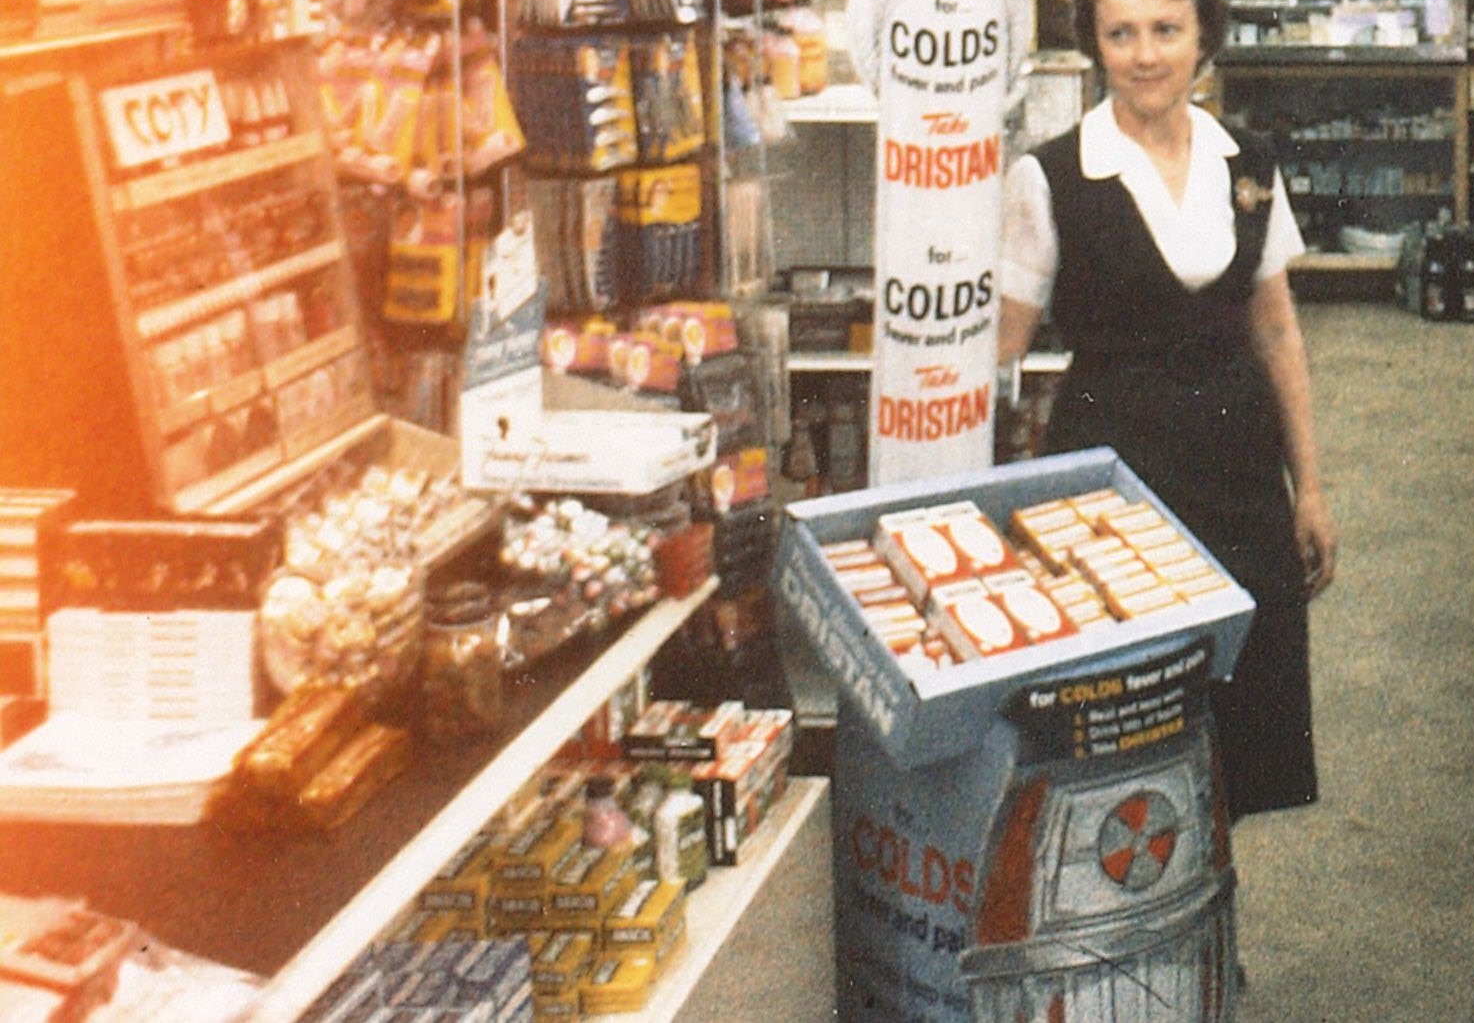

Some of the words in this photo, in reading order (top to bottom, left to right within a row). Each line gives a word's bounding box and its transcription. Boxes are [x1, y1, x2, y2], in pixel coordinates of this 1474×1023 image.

[889, 19, 1000, 68] COLDS
[883, 133, 1000, 191] DRISTAN
[884, 269, 993, 322] COLDS
[877, 383, 990, 443] DRISTAN
[1029, 688, 1057, 709] for
[850, 814, 975, 915] COLDS
